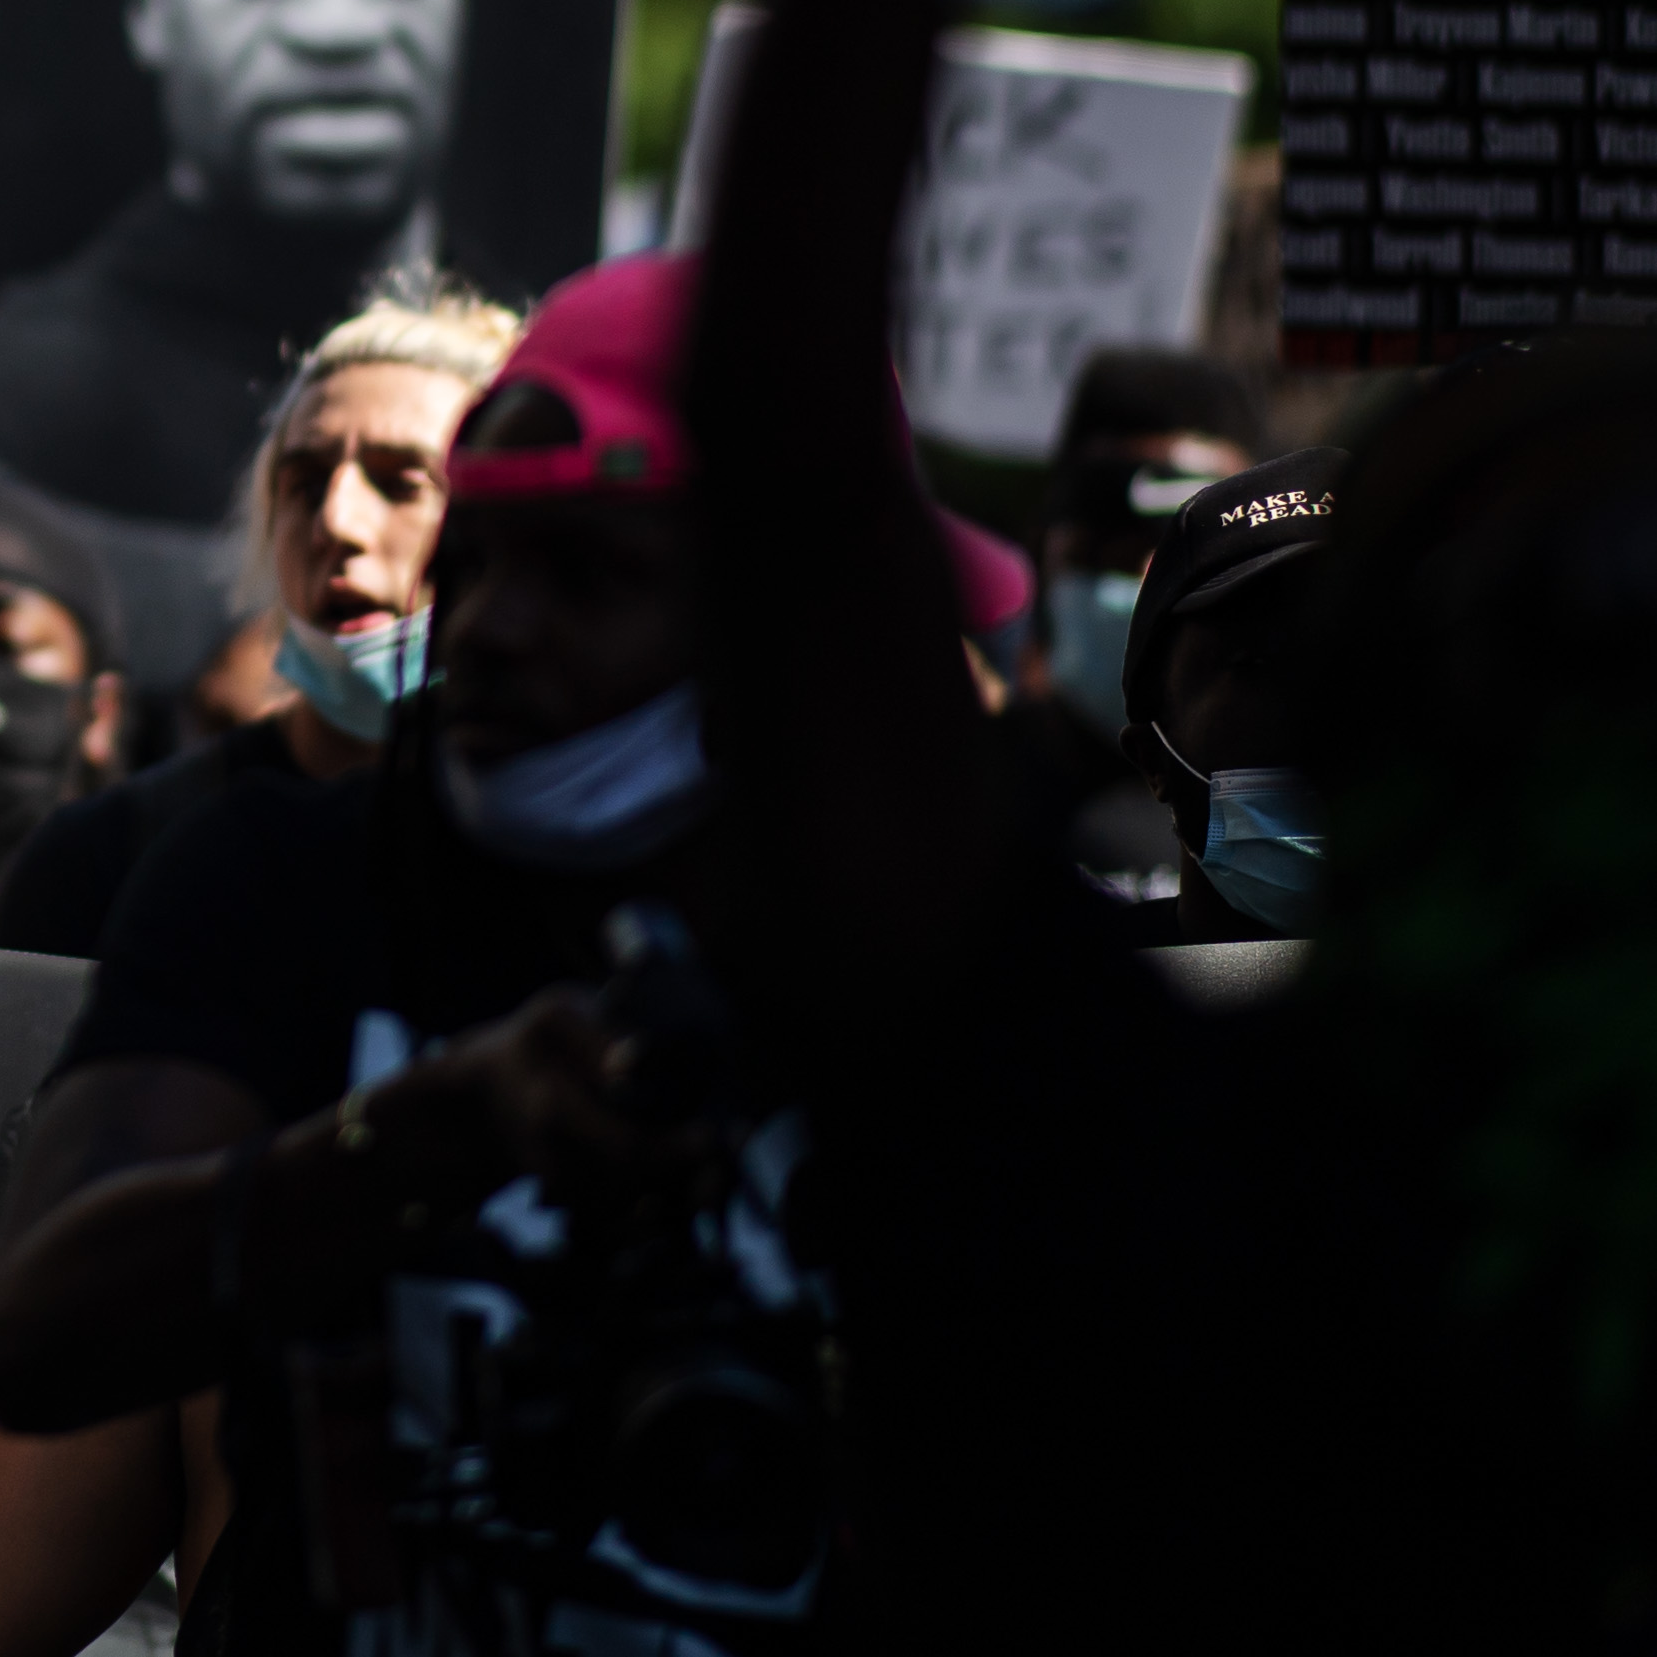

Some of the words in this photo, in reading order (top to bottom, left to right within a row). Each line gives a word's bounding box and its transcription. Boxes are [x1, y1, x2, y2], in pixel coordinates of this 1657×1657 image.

[1508, 3, 1600, 46] Martin
[1220, 491, 1307, 526] MAKE
[1319, 491, 1335, 503] A
[1249, 503, 1332, 528] READ
